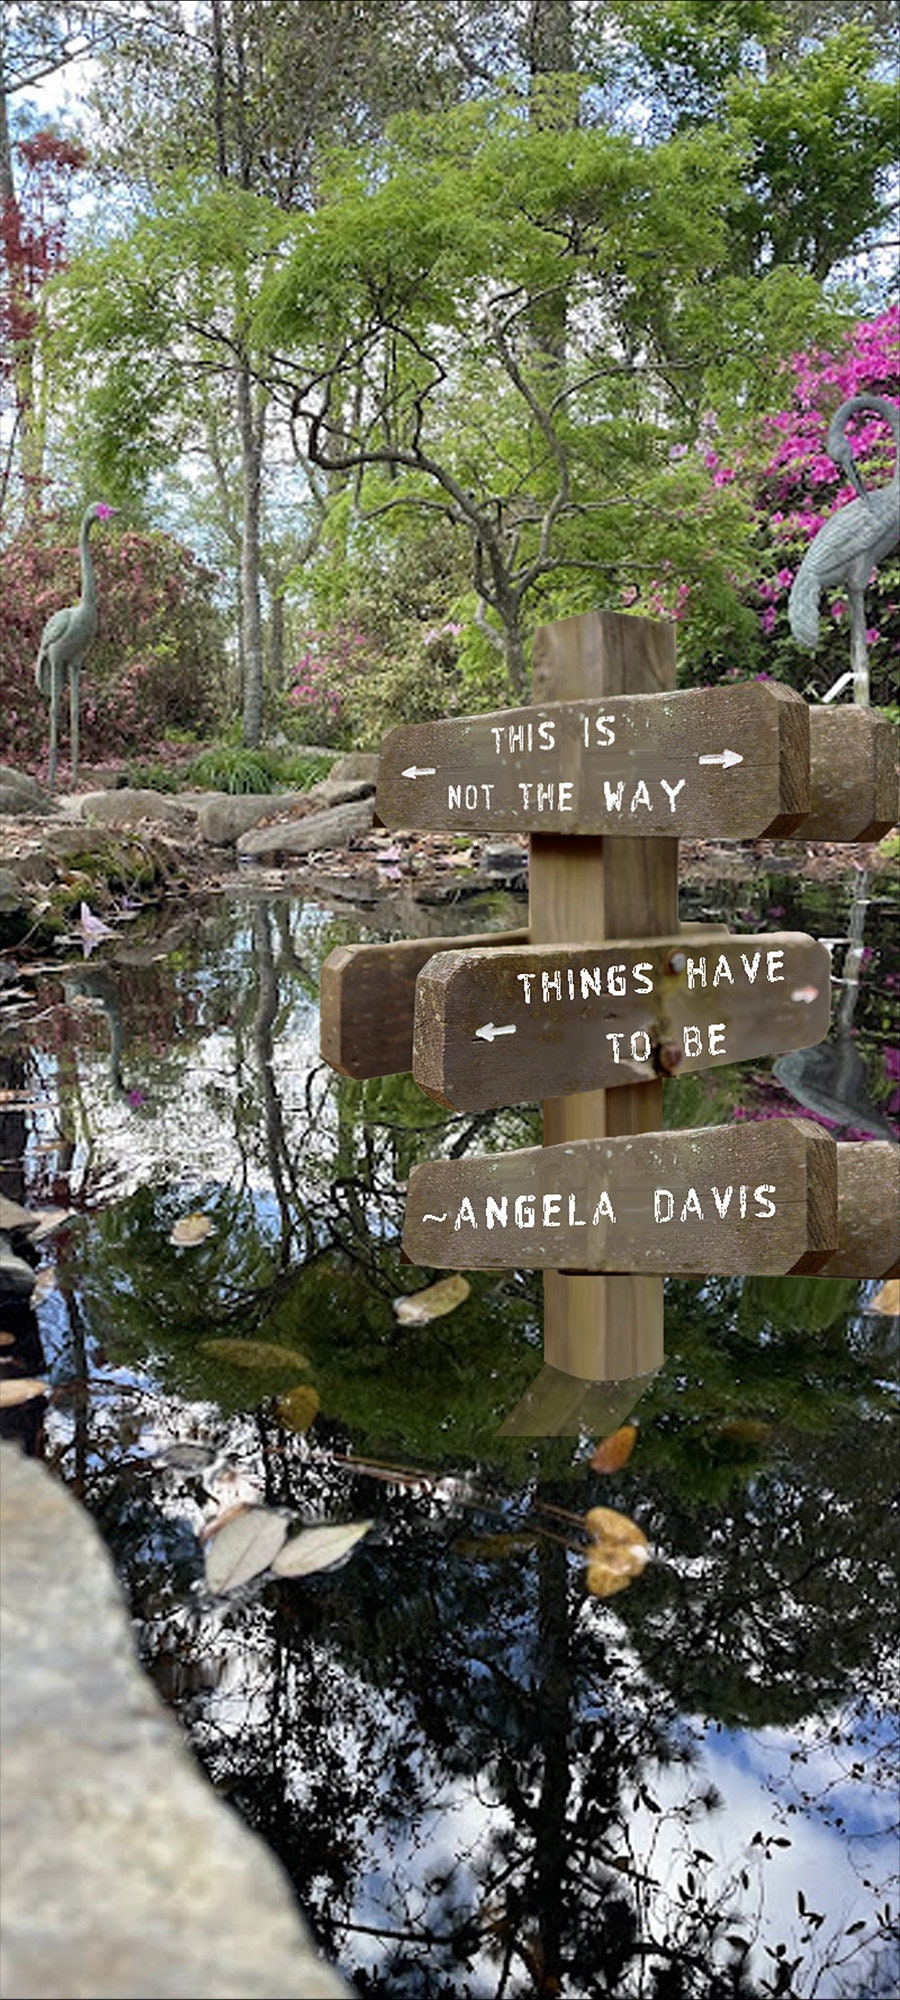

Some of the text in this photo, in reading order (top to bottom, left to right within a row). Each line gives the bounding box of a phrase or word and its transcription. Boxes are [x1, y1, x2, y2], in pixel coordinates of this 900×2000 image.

[491, 715, 615, 753] THIS IS
[449, 780, 685, 812] NOT THE WAY
[518, 951, 784, 1003] THINGS HAVE
[606, 1024, 726, 1063] TO BE
[655, 1185, 775, 1223] DAVIS
